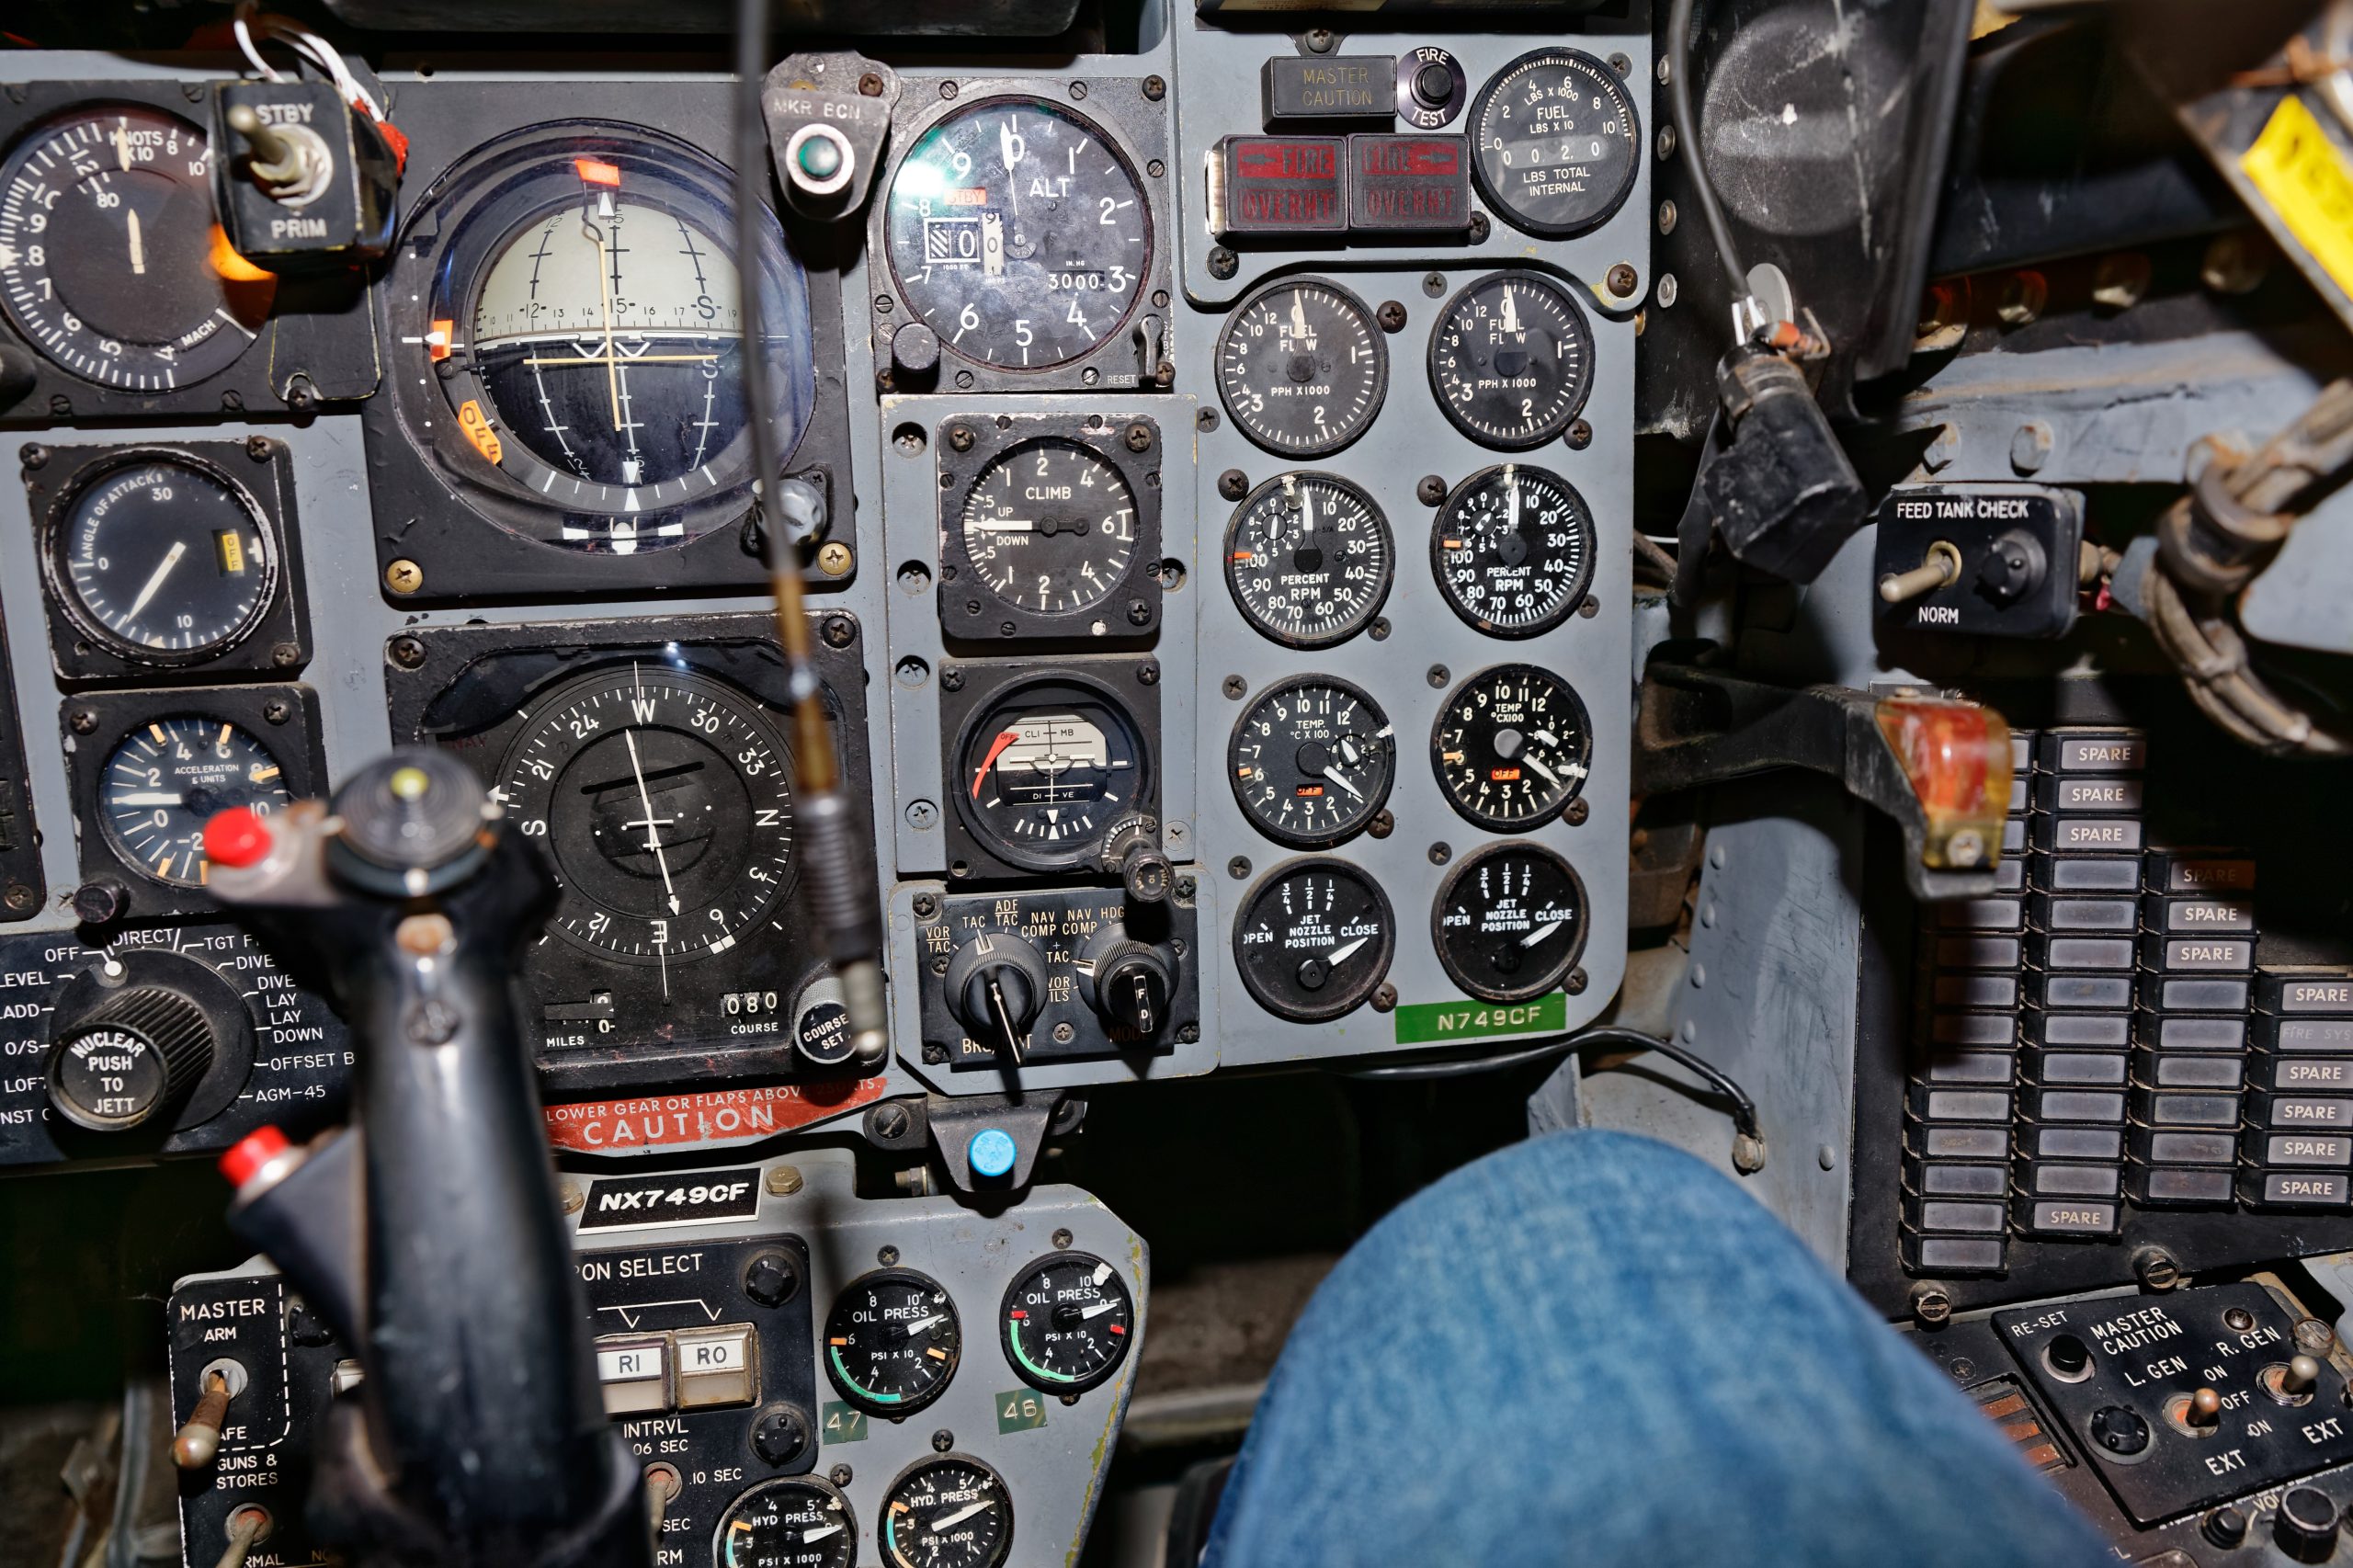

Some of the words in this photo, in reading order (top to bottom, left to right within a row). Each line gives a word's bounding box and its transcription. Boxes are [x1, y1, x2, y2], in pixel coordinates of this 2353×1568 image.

[1415, 49, 1450, 64] FIRE
[1303, 67, 1369, 84] MASTER
[1302, 89, 1372, 107] CAUTION
[1524, 92, 1544, 106] LBS
[1557, 87, 1579, 102] 1000
[259, 104, 313, 124] STBY
[774, 98, 812, 115] MKR
[1537, 106, 1569, 119] FUEL
[1411, 107, 1446, 125] TEST
[1529, 122, 1550, 133] LBS
[1562, 121, 1574, 131] 10
[110, 131, 163, 145] KNOTS
[1282, 147, 1331, 174] FIRE
[1364, 145, 1411, 170] FIRE
[1523, 171, 1547, 183] LBS
[1552, 167, 1590, 181] TOTAL
[1029, 178, 1070, 198] ALT
[1529, 182, 1586, 197] INTERNAL
[1243, 195, 1333, 221] OVERHT
[1368, 192, 1456, 217] OVERHT
[271, 220, 326, 239] PRIM
[182, 320, 216, 347] MACH
[1108, 375, 1136, 384] RESET
[1478, 380, 1499, 389] PPH
[1512, 379, 1537, 388] 1000
[1271, 387, 1291, 396] PPH
[1037, 458, 1048, 475] 2
[153, 487, 173, 500] 30
[1025, 487, 1071, 500] CLIMB
[998, 507, 1013, 517] UP
[1897, 502, 1932, 518] FEED
[1936, 502, 1973, 518] TANK
[1977, 500, 2029, 517] CHECK
[83, 517, 100, 559] ANGLE
[94, 499, 109, 517] OF
[108, 475, 155, 502] ATTACK
[1102, 517, 1114, 533] 6
[996, 536, 1029, 546] DOWN
[1347, 540, 1366, 554] 30
[1346, 567, 1364, 581] 40
[1487, 566, 1531, 577] PERCENT
[1039, 576, 1050, 594] 2
[1281, 574, 1329, 585] PERCENT
[1495, 579, 1523, 591] RPM
[1534, 579, 1552, 593] 50
[1290, 587, 1321, 601] RPM
[1918, 607, 1959, 624] NORM
[631, 699, 655, 722] W
[1495, 703, 1521, 713] TEMP
[1314, 729, 1329, 739] 100
[2079, 747, 2131, 762] SPARE
[175, 765, 239, 775] ACCELERATION
[739, 751, 765, 775] 33
[200, 774, 225, 783] UNITS
[2072, 788, 2123, 802] SPARE
[2071, 828, 2122, 843] SPARE
[2184, 869, 2236, 882] SPARE
[995, 900, 1017, 912] ADF
[1496, 899, 1517, 910] JET
[1031, 912, 1055, 924] NAV
[1067, 909, 1091, 921] NAV
[1100, 906, 1124, 919] HDG
[1301, 915, 1321, 925] JET
[1486, 909, 1527, 920] NOZZLE
[1535, 909, 1572, 922] CLOSE
[2185, 907, 2237, 922] SPARE
[963, 915, 985, 928] TAC
[995, 915, 1018, 926] TAC
[1482, 921, 1529, 932] POSITION
[926, 926, 950, 938] VOR
[1021, 924, 1056, 937] COMP
[1063, 922, 1097, 935] COMP
[1290, 926, 1331, 937] NOZZLE
[1341, 924, 1378, 937] CLOSE
[112, 929, 173, 947] DIRECT
[203, 937, 234, 950] TGT
[1285, 937, 1335, 949] POSITION
[45, 947, 80, 961] OFF
[928, 941, 950, 953] TAC
[2181, 947, 2233, 961] SPARE
[237, 955, 275, 971] DIVE
[1047, 952, 1069, 963] TAC
[257, 974, 296, 989] DIVE
[1048, 977, 1070, 989] VOR
[266, 994, 297, 1007] LAY
[1051, 990, 1069, 1003] ILS
[2296, 987, 2348, 1002] SPARE
[270, 1011, 301, 1025] LAY
[1438, 1006, 1541, 1031] N749CF
[731, 1022, 779, 1034] COURSE
[802, 1014, 848, 1044] COURSE
[2282, 1028, 2314, 1040] FIRE
[274, 1028, 323, 1044] DOWN
[546, 1036, 585, 1047] MILES
[822, 1033, 844, 1050] SET
[6, 1040, 38, 1055] O/S
[71, 1031, 145, 1059] NUCLEAR
[88, 1056, 132, 1072] PUSH
[270, 1053, 335, 1072] OFFSET
[2290, 1065, 2342, 1080] SPARE
[101, 1077, 123, 1092] TO
[256, 1086, 325, 1103] AGM-45
[94, 1097, 134, 1113] JETT
[546, 1105, 607, 1121] LOWER
[614, 1099, 660, 1115] GEAR
[666, 1097, 689, 1110] OR
[696, 1092, 745, 1107] FLAPS
[2284, 1105, 2336, 1119] SPARE
[584, 1104, 773, 1145] CAUTION
[2284, 1142, 2336, 1156] SPARE
[2281, 1181, 2333, 1196] SPARE
[599, 1182, 749, 1211] NX749CF
[2051, 1210, 2100, 1226] SPARE
[620, 1253, 703, 1278] SELECT
[1027, 1292, 1050, 1305] OIL
[1058, 1288, 1100, 1301] PRESS
[180, 1299, 265, 1321] MASTER
[853, 1308, 877, 1323] OIL
[884, 1307, 928, 1320] PRESS
[2011, 1311, 2069, 1337] RE-SET
[2090, 1306, 2167, 1340] MASTER
[204, 1327, 236, 1342] ARM
[1046, 1333, 1060, 1342] PSI
[2103, 1320, 2183, 1356] CAUTION
[2245, 1326, 2281, 1352] GEN
[697, 1347, 727, 1365] RO
[871, 1352, 889, 1360] PSI
[2124, 1371, 2147, 1387] L.
[2147, 1356, 2188, 1381] GEN
[2204, 1365, 2228, 1382] ON
[2221, 1391, 2252, 1410] OFF
[1004, 1400, 1037, 1419] 46
[827, 1411, 860, 1430] 47
[623, 1419, 688, 1438] INTRVL
[2250, 1420, 2273, 1437] ON
[2302, 1418, 2344, 1444] EXT
[660, 1439, 688, 1454] SEC
[218, 1455, 257, 1471] GUNS
[2205, 1449, 2246, 1476] EXT
[216, 1472, 278, 1490] STORES
[714, 1469, 742, 1483] SEC
[662, 1518, 690, 1532] SEC
[753, 1516, 778, 1527] HYD
[922, 1536, 938, 1546] PSI
[951, 1531, 974, 1542] 1000
[758, 1558, 778, 1567] PSI
[798, 1554, 822, 1563] 1000
